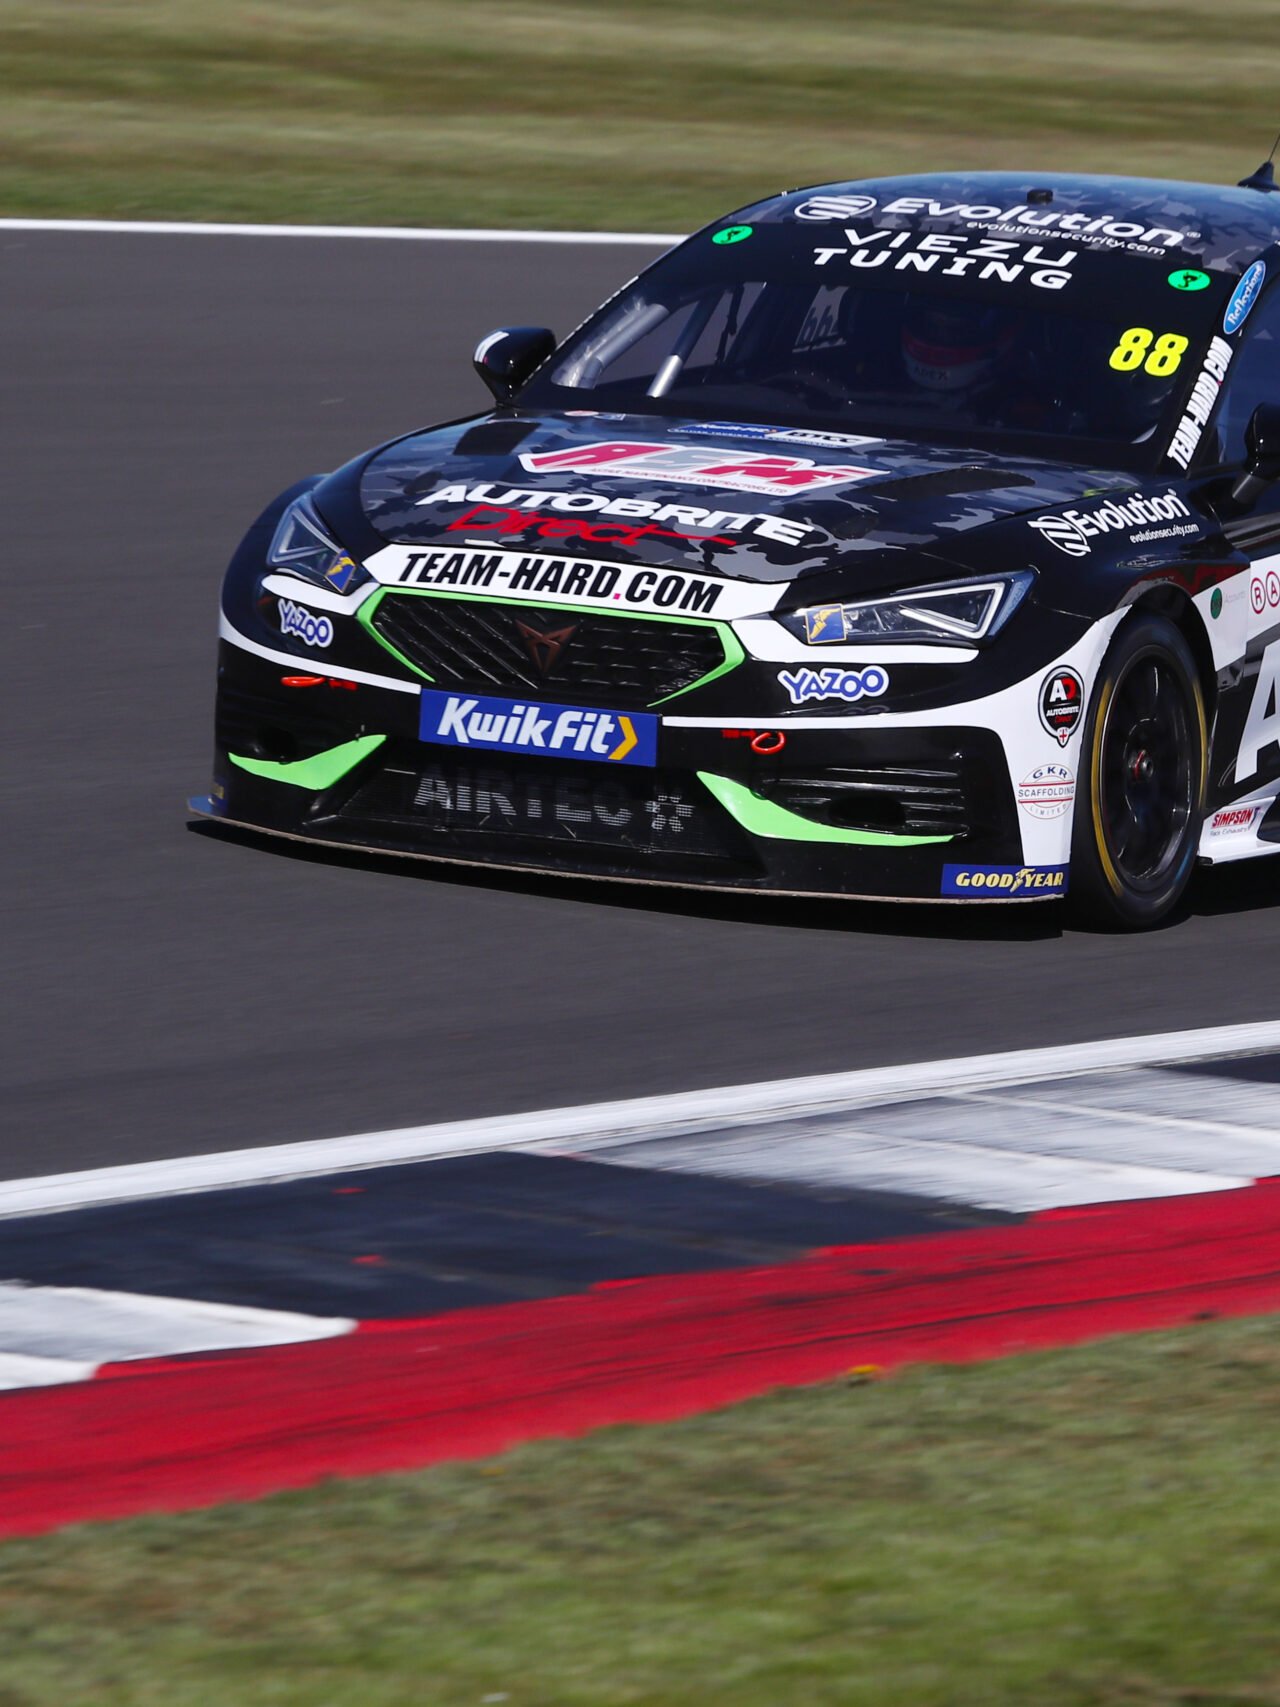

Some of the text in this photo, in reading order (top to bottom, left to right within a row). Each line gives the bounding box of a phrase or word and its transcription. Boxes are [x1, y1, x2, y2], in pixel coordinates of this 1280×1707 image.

[881, 197, 1185, 247] Evolution
[966, 221, 1166, 257] evolutionsecurity.com
[813, 248, 1073, 290] TUNING
[844, 228, 1078, 268] VIEZU
[1109, 327, 1189, 377] 88
[415, 484, 815, 546] AUTOBRITE
[446, 504, 737, 547] Direct
[1062, 492, 1190, 537] Evolution
[398, 553, 724, 614] TEAM-HARD.COM
[278, 598, 333, 648] YAZOO
[777, 665, 889, 704] YAZOO
[1018, 785, 1075, 798] SCAFFOLDING
[1032, 766, 1069, 780] GKR
[1212, 808, 1254, 828] SIMPSON
